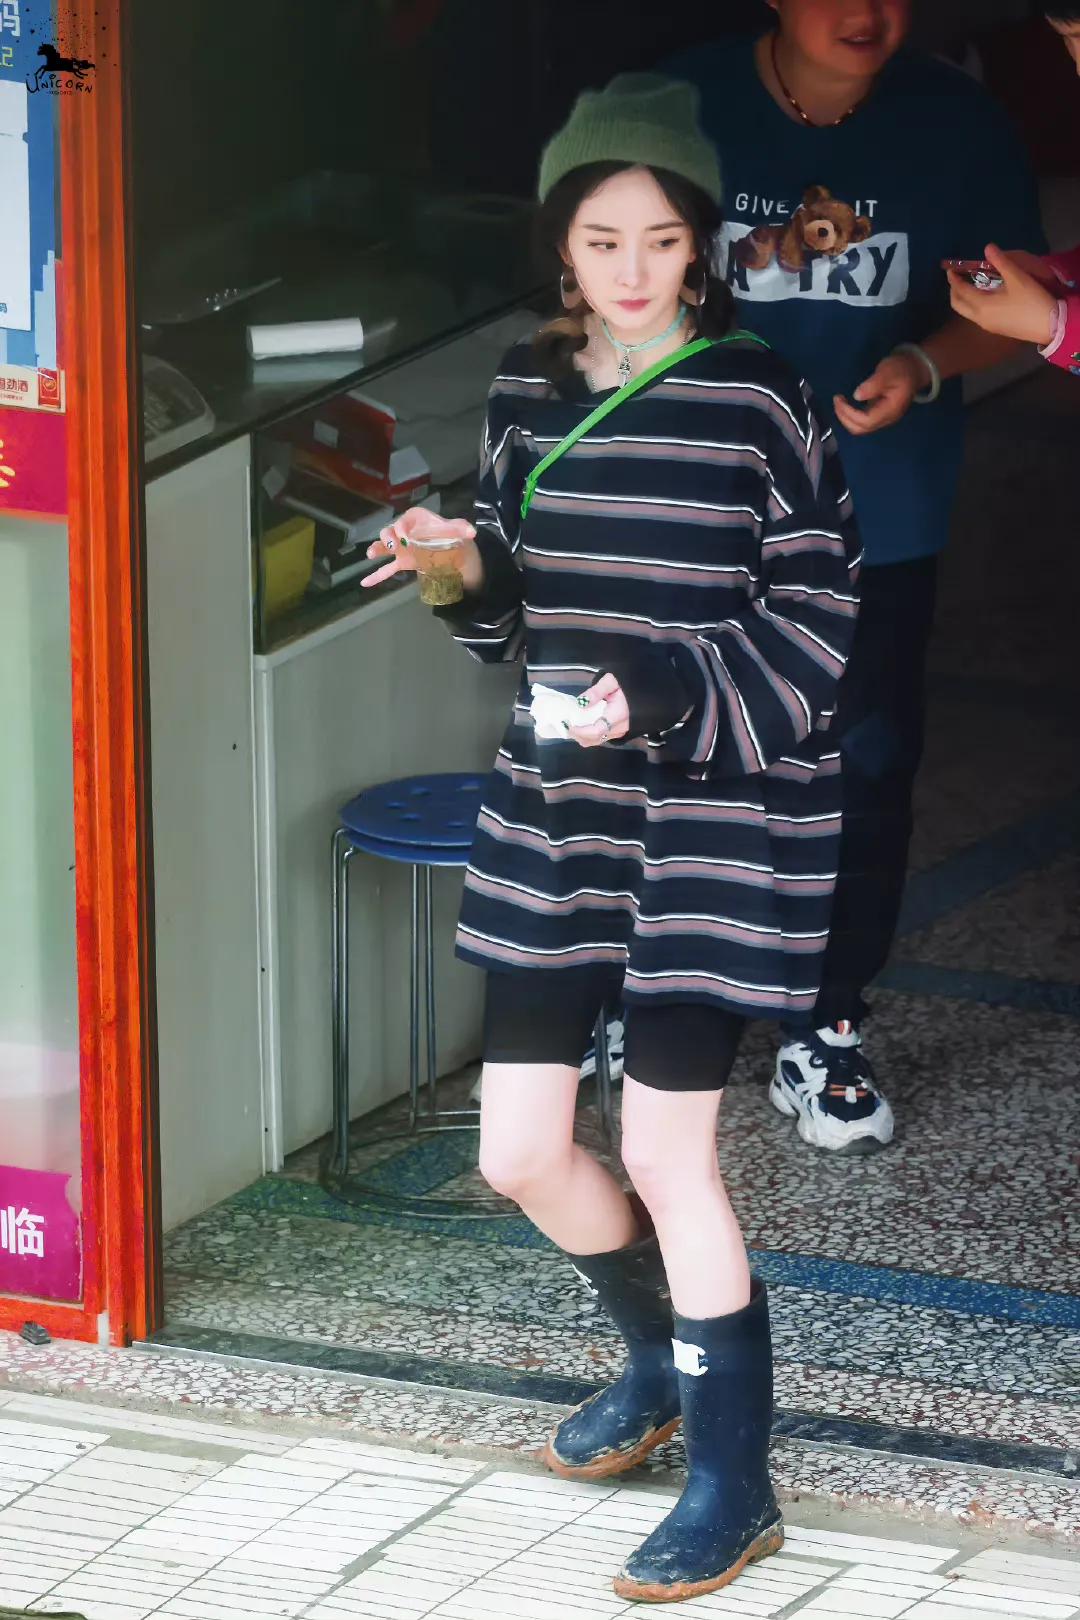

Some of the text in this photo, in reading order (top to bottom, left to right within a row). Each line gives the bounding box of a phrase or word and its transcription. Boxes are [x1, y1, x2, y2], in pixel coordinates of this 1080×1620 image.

[735, 193, 879, 218] GIVE IT
[0, 1205, 44, 1258] 临
